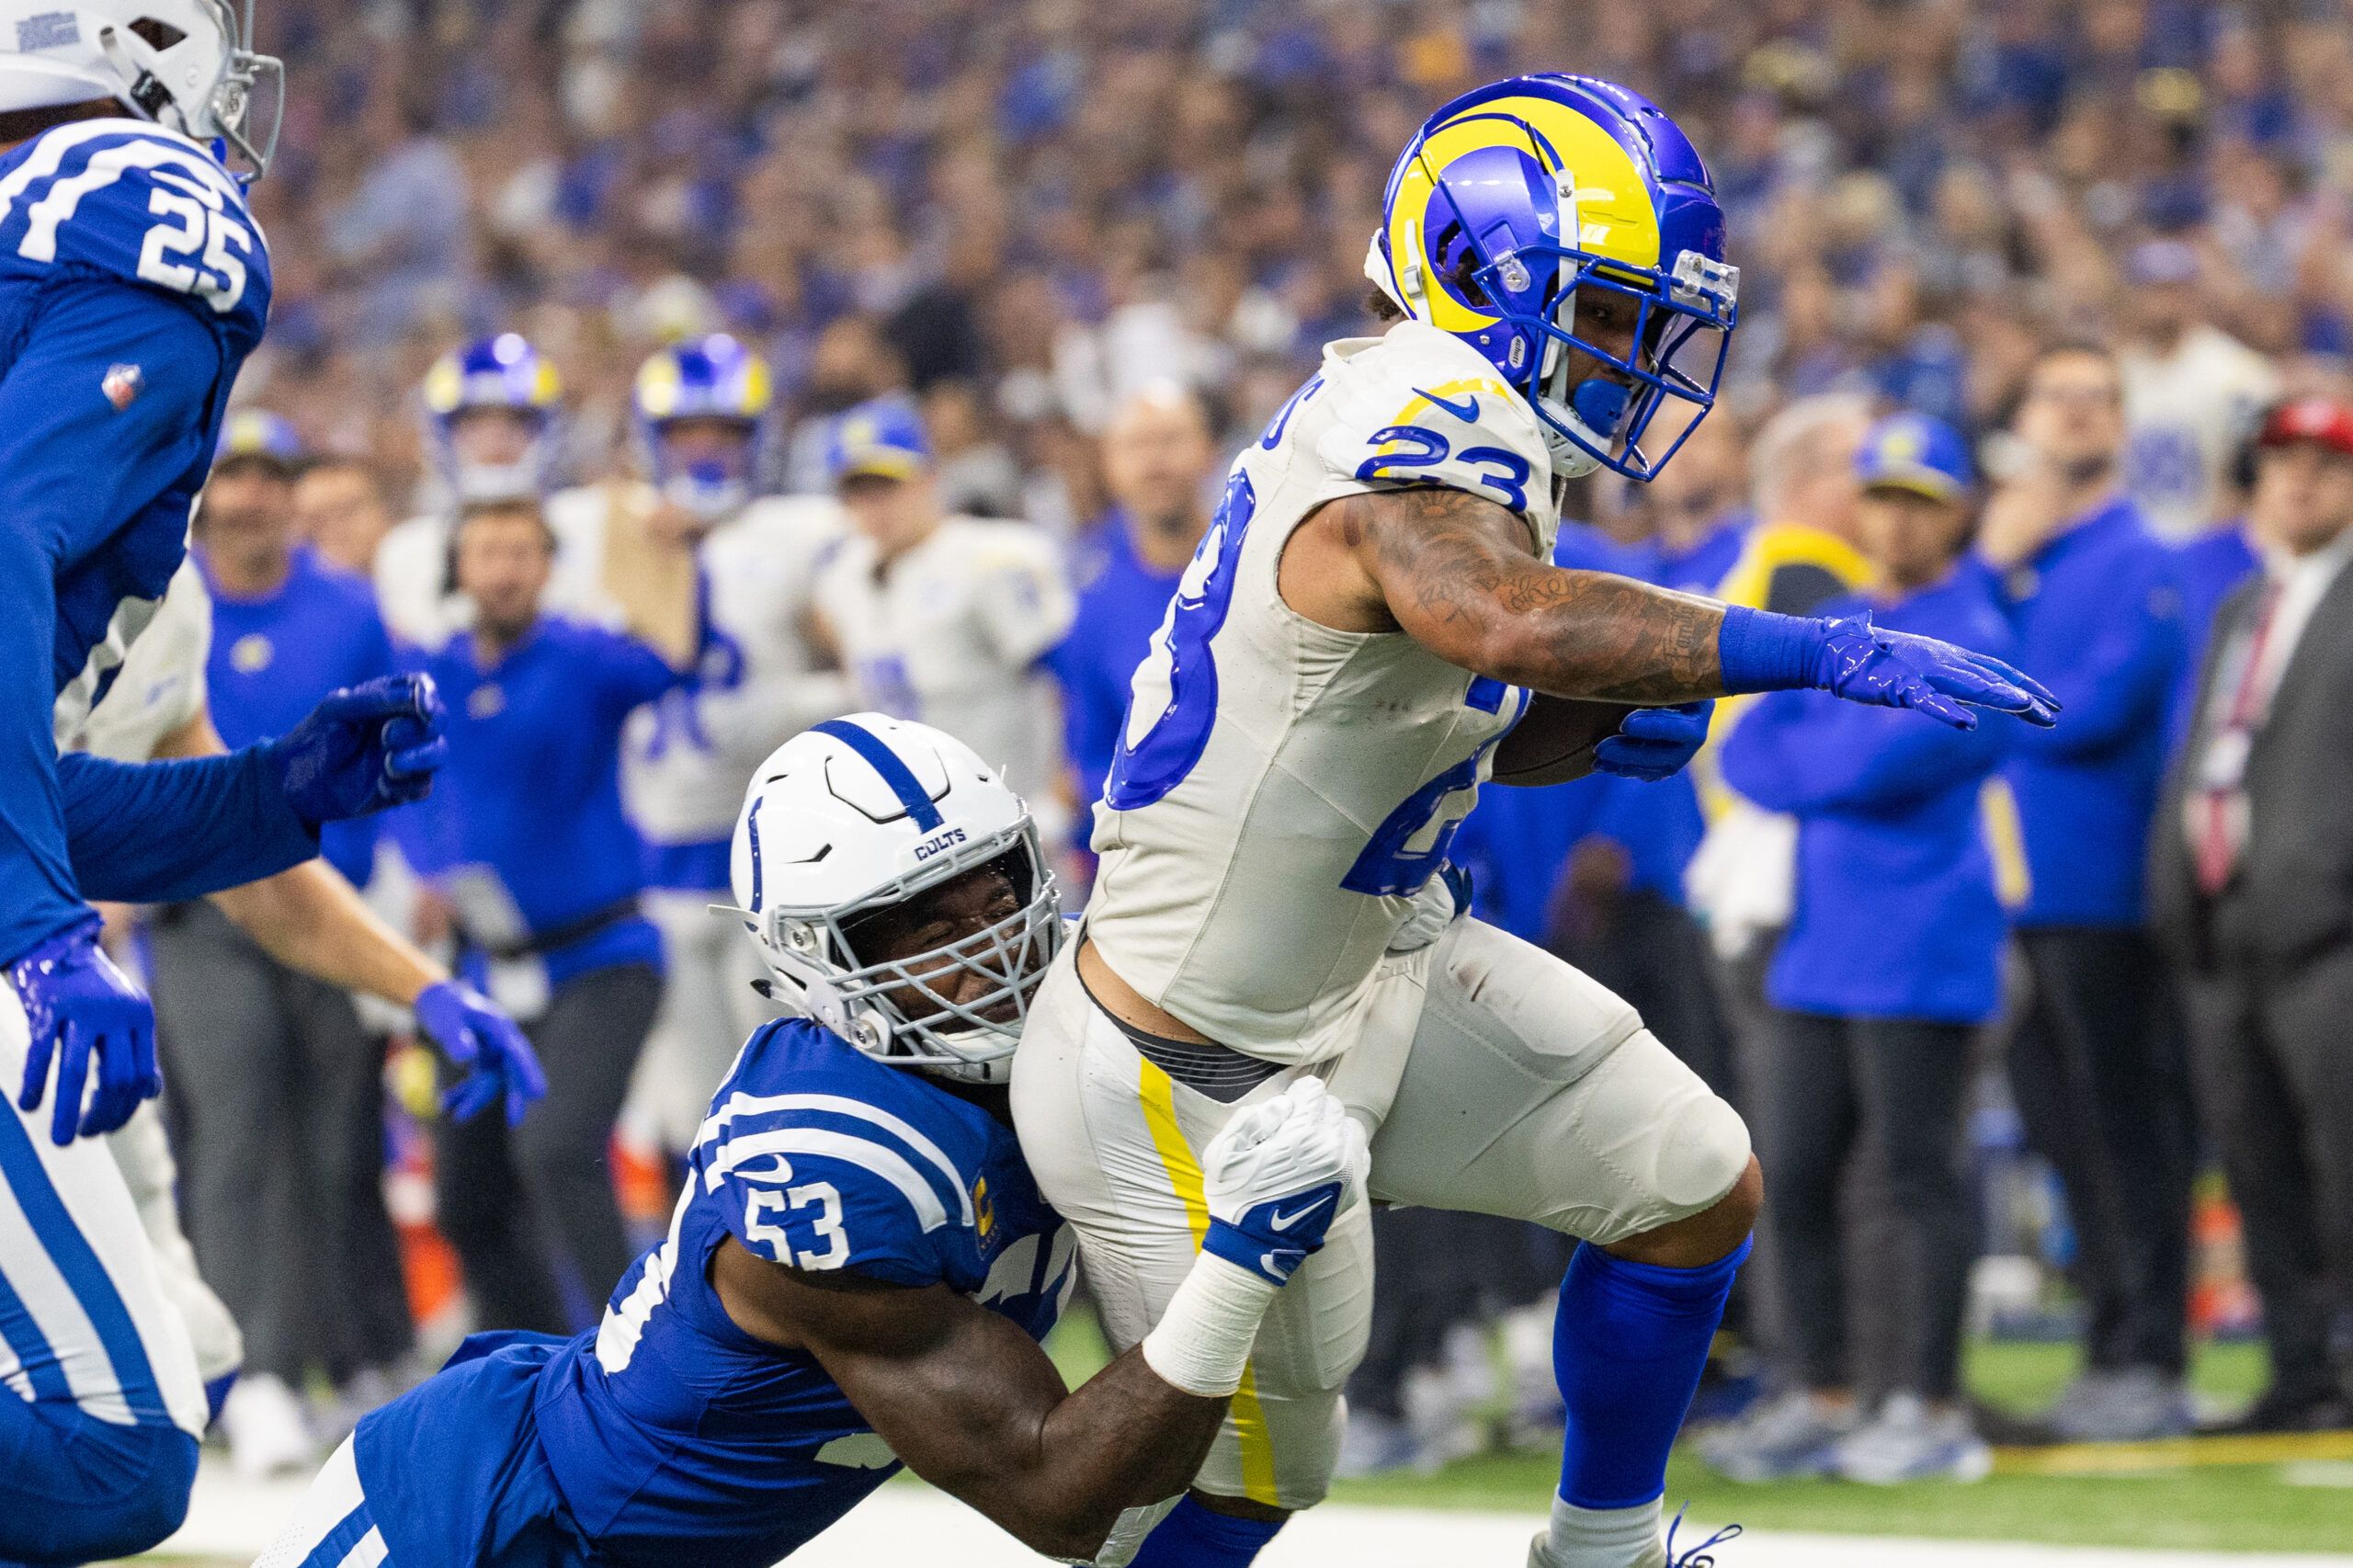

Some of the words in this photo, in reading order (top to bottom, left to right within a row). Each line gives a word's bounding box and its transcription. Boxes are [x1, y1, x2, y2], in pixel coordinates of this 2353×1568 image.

[137, 187, 252, 313] 25
[1355, 426, 1531, 513] 23
[915, 827, 967, 861] COLTS
[745, 1180, 850, 1272] 53
